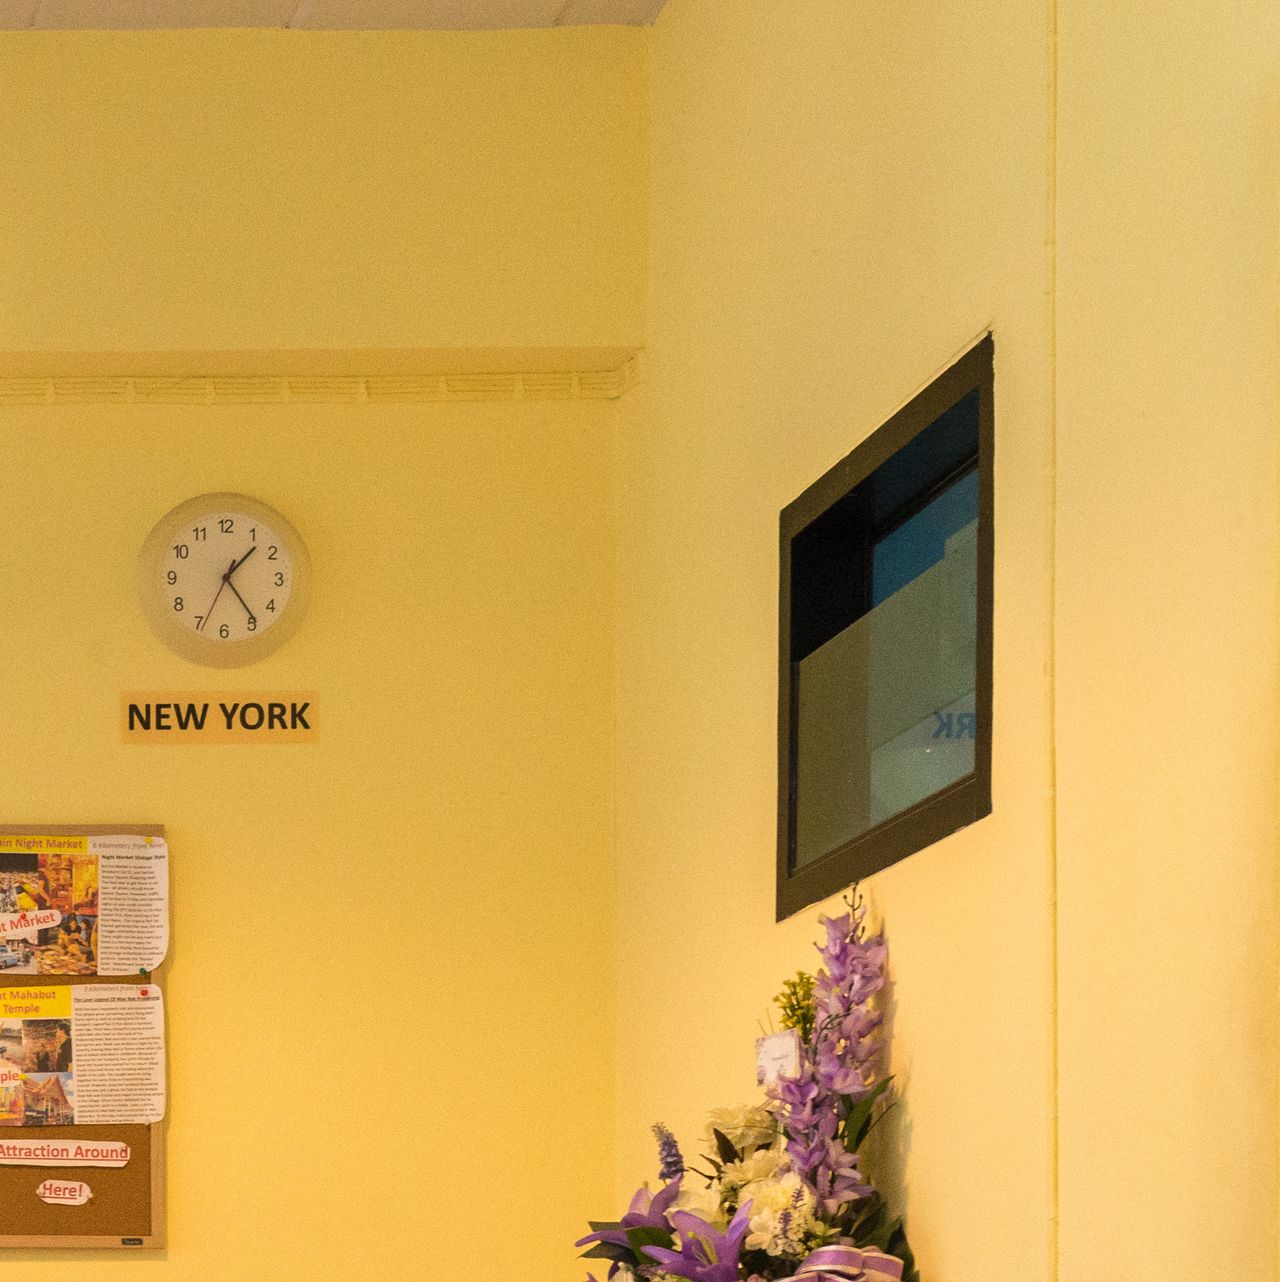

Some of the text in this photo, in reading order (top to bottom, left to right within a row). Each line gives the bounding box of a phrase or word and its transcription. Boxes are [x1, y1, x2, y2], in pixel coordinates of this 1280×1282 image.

[218, 519, 234, 533] 12
[193, 527, 206, 541] 11
[249, 528, 256, 541] 1
[173, 544, 189, 559] 10
[268, 546, 277, 560] 2
[167, 571, 177, 585] 9
[274, 572, 284, 586] 3
[174, 597, 184, 611] 8
[266, 599, 276, 612] 4
[194, 616, 203, 630] 7
[219, 624, 229, 638] 6
[128, 702, 311, 731] NEW YORK
[16, 839, 42, 849] Night
[46, 840, 82, 848] Market
[9, 912, 56, 930] Market
[10, 991, 56, 1000] Mahabut
[3, 1004, 40, 1013] Temple
[74, 1145, 129, 1160] Around
[42, 1184, 83, 1198] Here!
